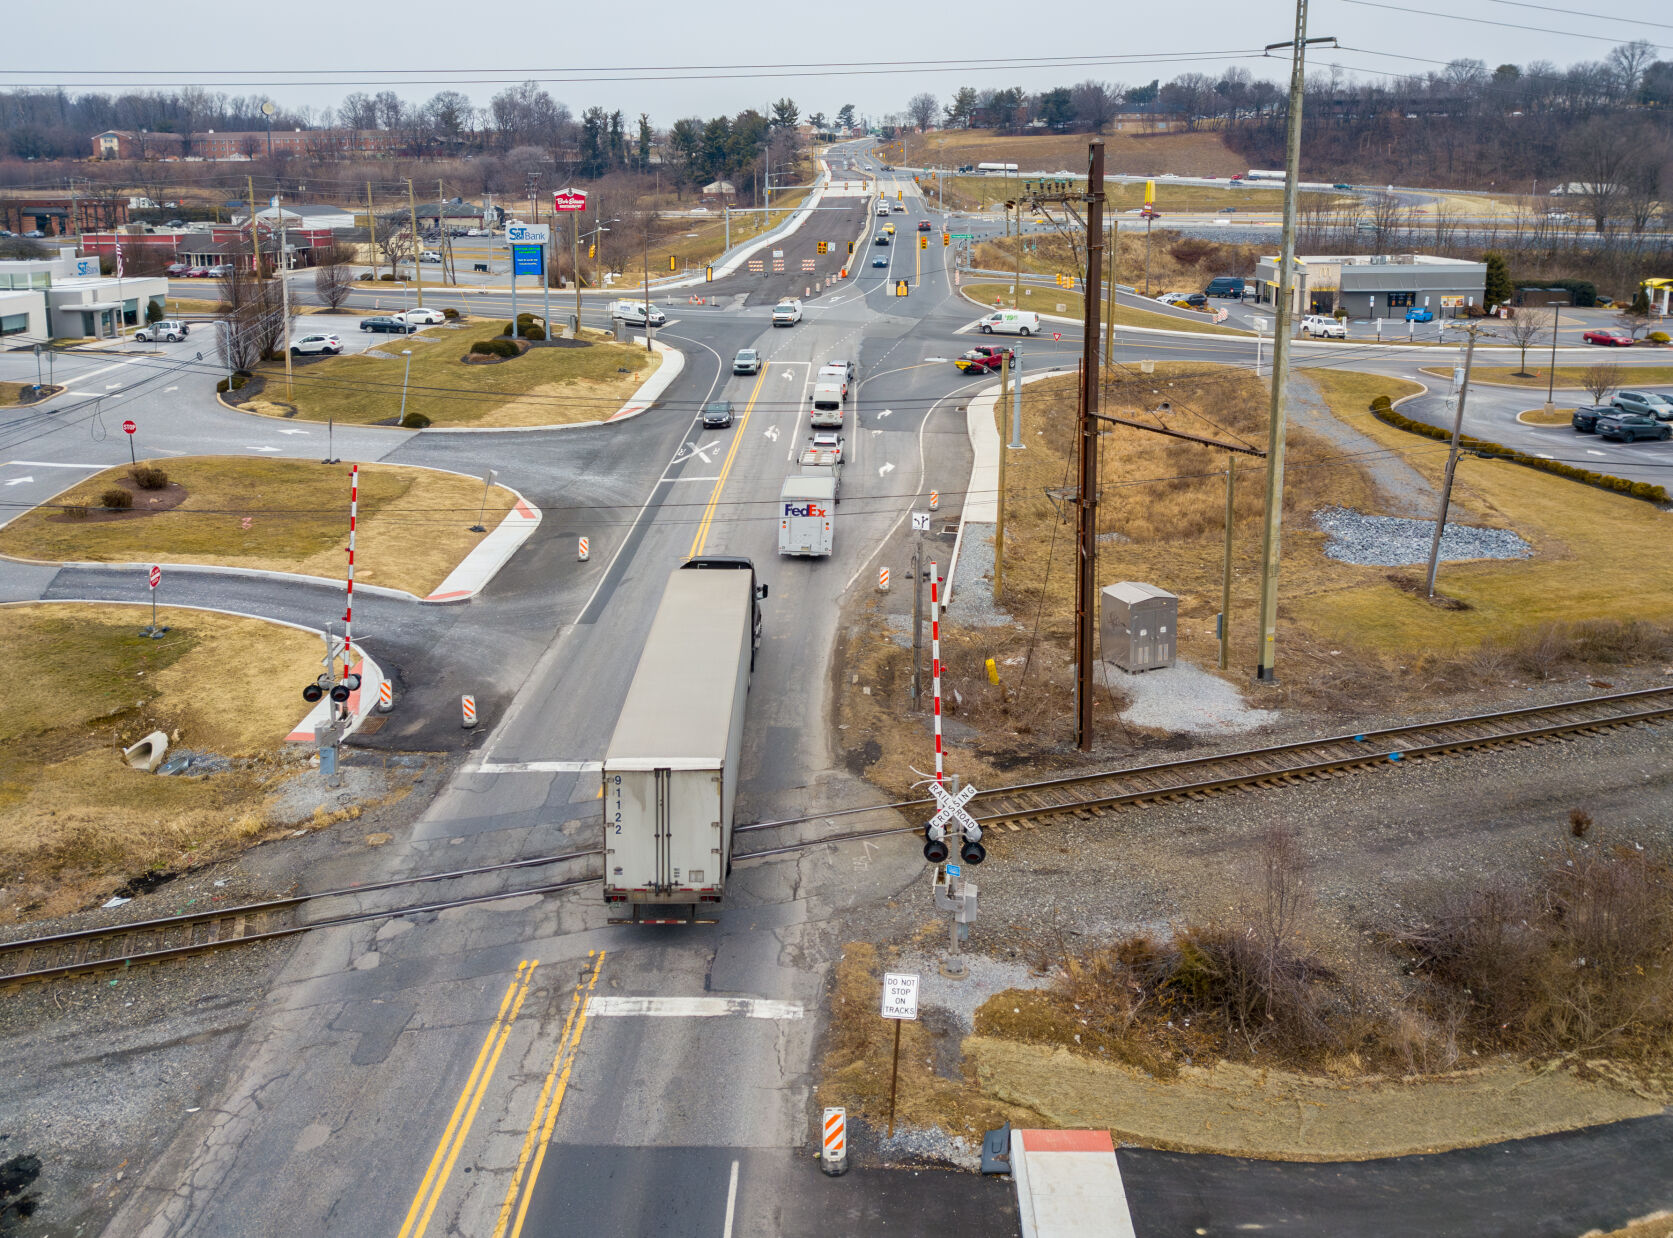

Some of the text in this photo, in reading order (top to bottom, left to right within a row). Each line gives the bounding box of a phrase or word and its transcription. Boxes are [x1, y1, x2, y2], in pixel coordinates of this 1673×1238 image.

[525, 232, 546, 240] Bank
[784, 504, 827, 518] FedEx
[932, 786, 976, 828] CROSSING
[901, 978, 916, 986] NOT
[891, 988, 911, 996] STOP
[885, 1006, 915, 1014] TRACKS
